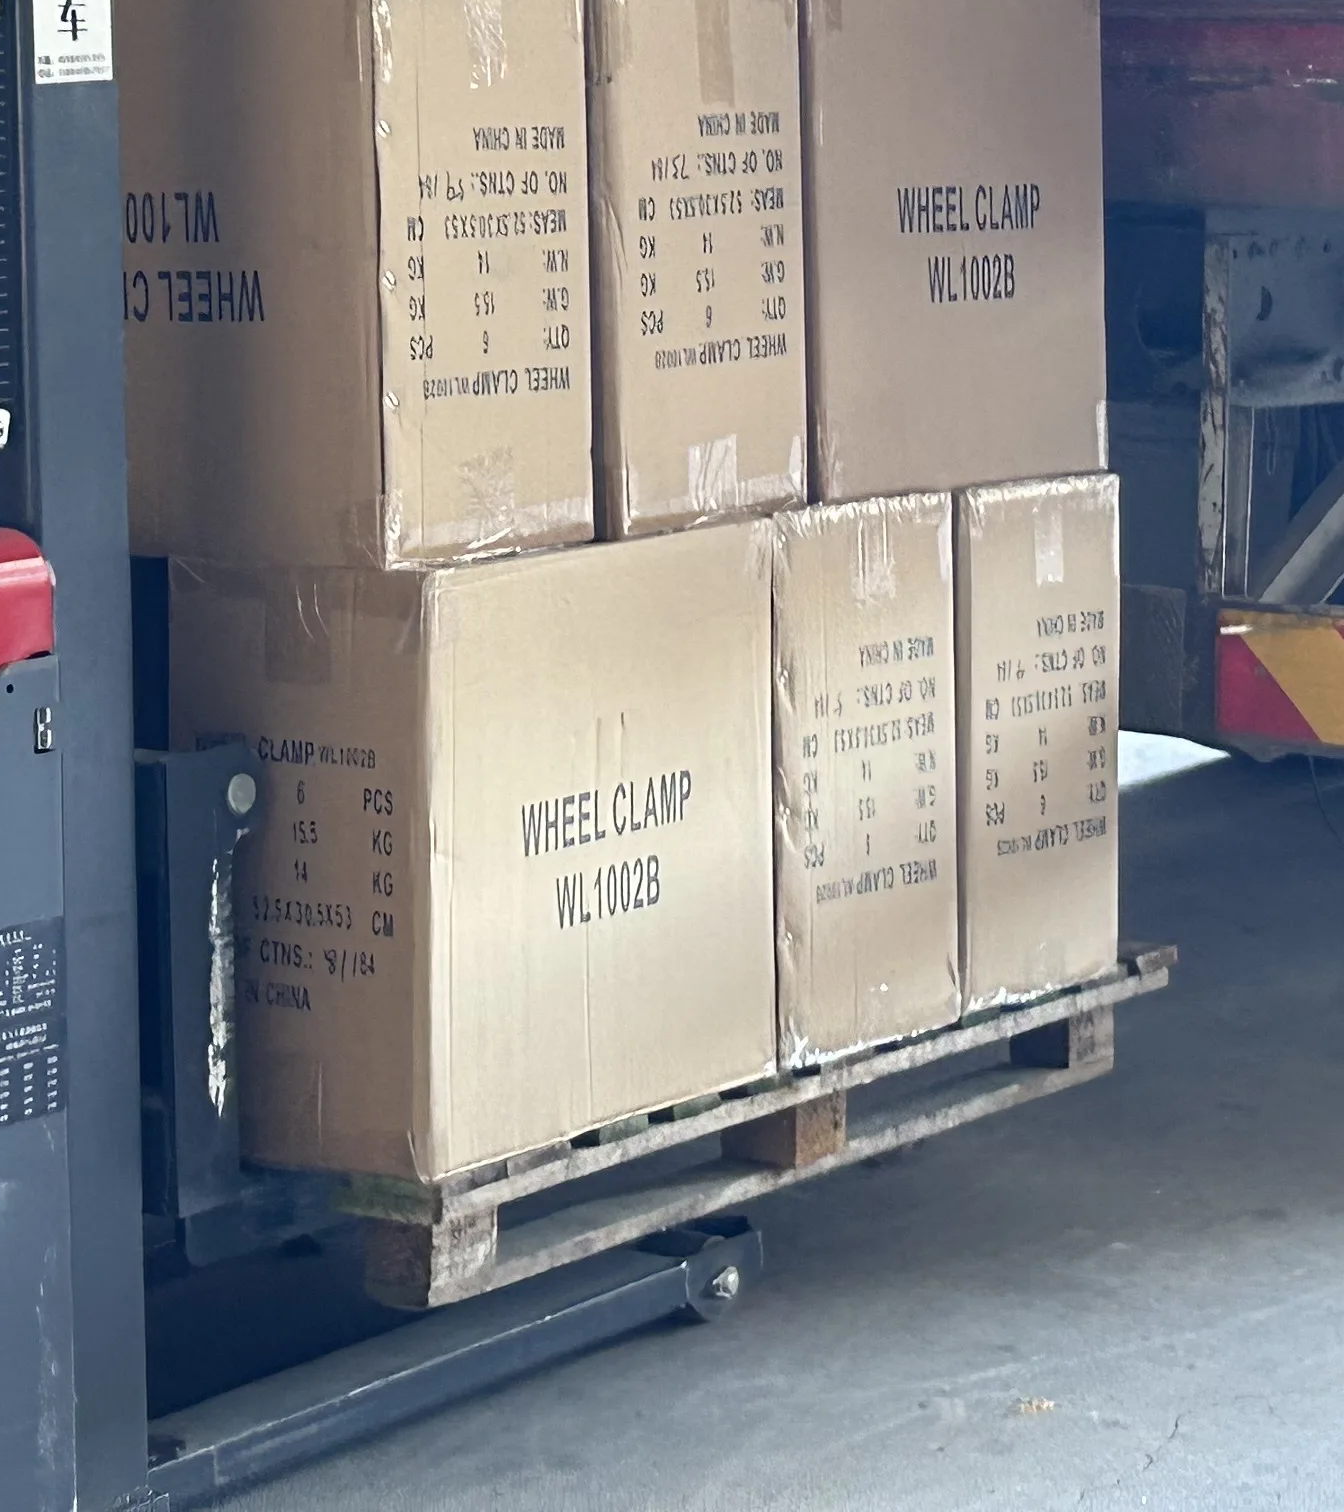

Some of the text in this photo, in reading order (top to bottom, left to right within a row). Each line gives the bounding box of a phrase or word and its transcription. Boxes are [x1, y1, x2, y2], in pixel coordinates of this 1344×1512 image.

[697, 111, 780, 137] MADE IN CHINA
[473, 126, 565, 151] MADE IN CHINA
[742, 150, 757, 175] OF
[762, 148, 783, 173] NO.
[521, 171, 538, 196] OF
[544, 170, 567, 195] NO.
[126, 191, 220, 243] WL100
[897, 183, 1040, 233] WHEEL CLAMP
[406, 215, 424, 242] CM
[528, 209, 567, 235] MEAS:
[639, 234, 655, 259] KG
[407, 255, 424, 280] KG
[928, 253, 1015, 303] WL1002B
[158, 270, 265, 322] WHEEL
[640, 272, 656, 297] KG
[409, 295, 425, 321] KG
[640, 309, 663, 336] PCS
[409, 324, 570, 360] QTY: 6 PCS
[699, 332, 787, 365] WHEEL CLAMP
[472, 366, 571, 397] WHEEL CLAMP
[257, 736, 314, 766] CLAMP
[296, 780, 393, 816] 6 PCS
[522, 770, 691, 857] WHEEL CLAMP
[372, 829, 393, 856] KG
[372, 872, 393, 897] KG
[556, 854, 660, 930] WL1002B
